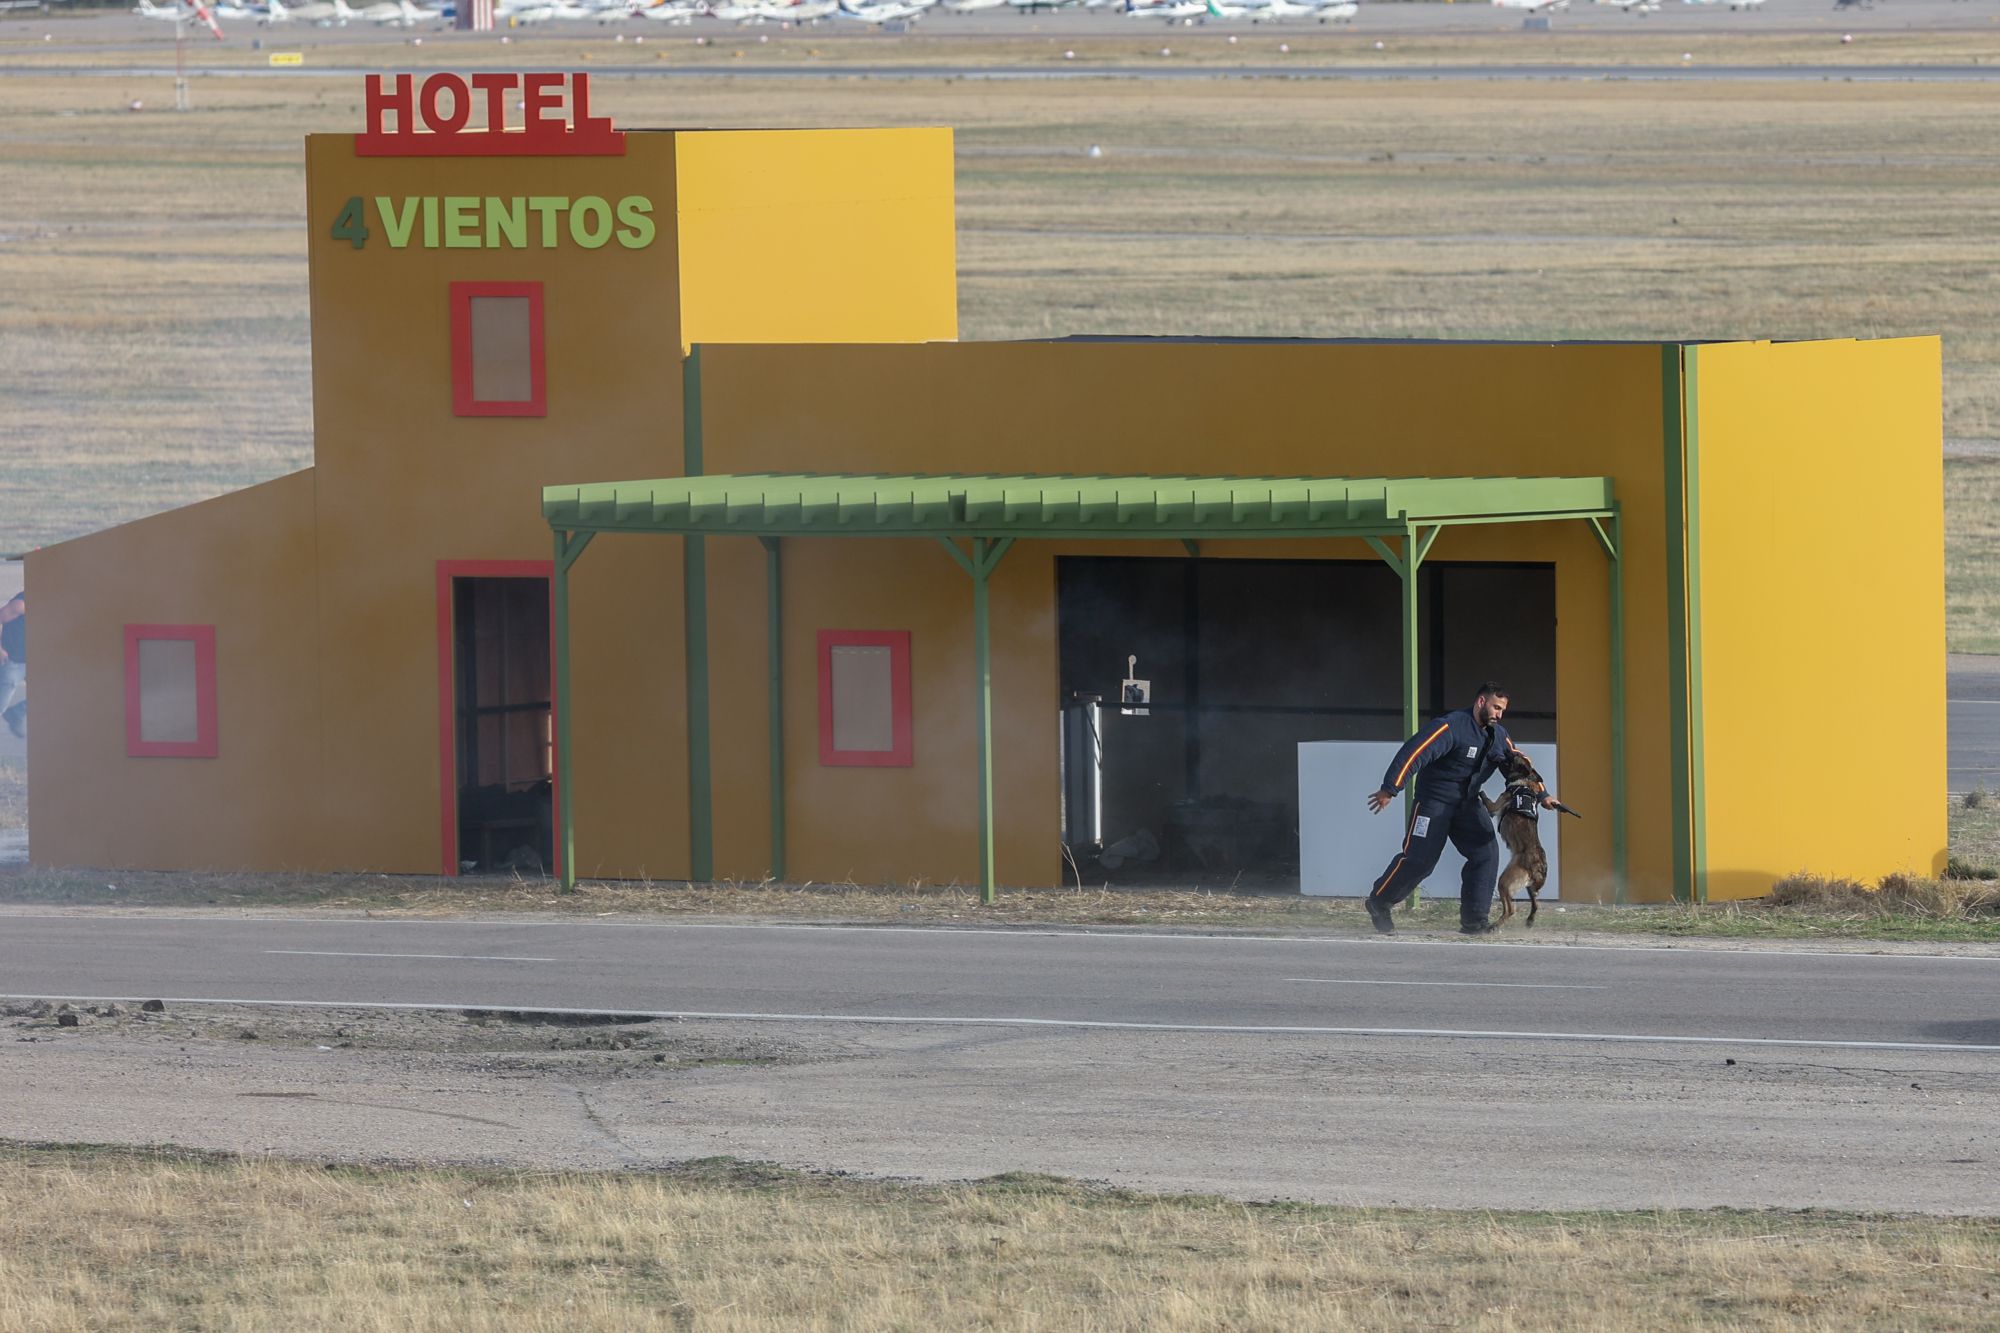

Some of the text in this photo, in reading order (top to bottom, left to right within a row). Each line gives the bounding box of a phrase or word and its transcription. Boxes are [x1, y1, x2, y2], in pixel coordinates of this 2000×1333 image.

[365, 72, 613, 134] HOTEL
[331, 195, 656, 249] 4 VIENTOS
